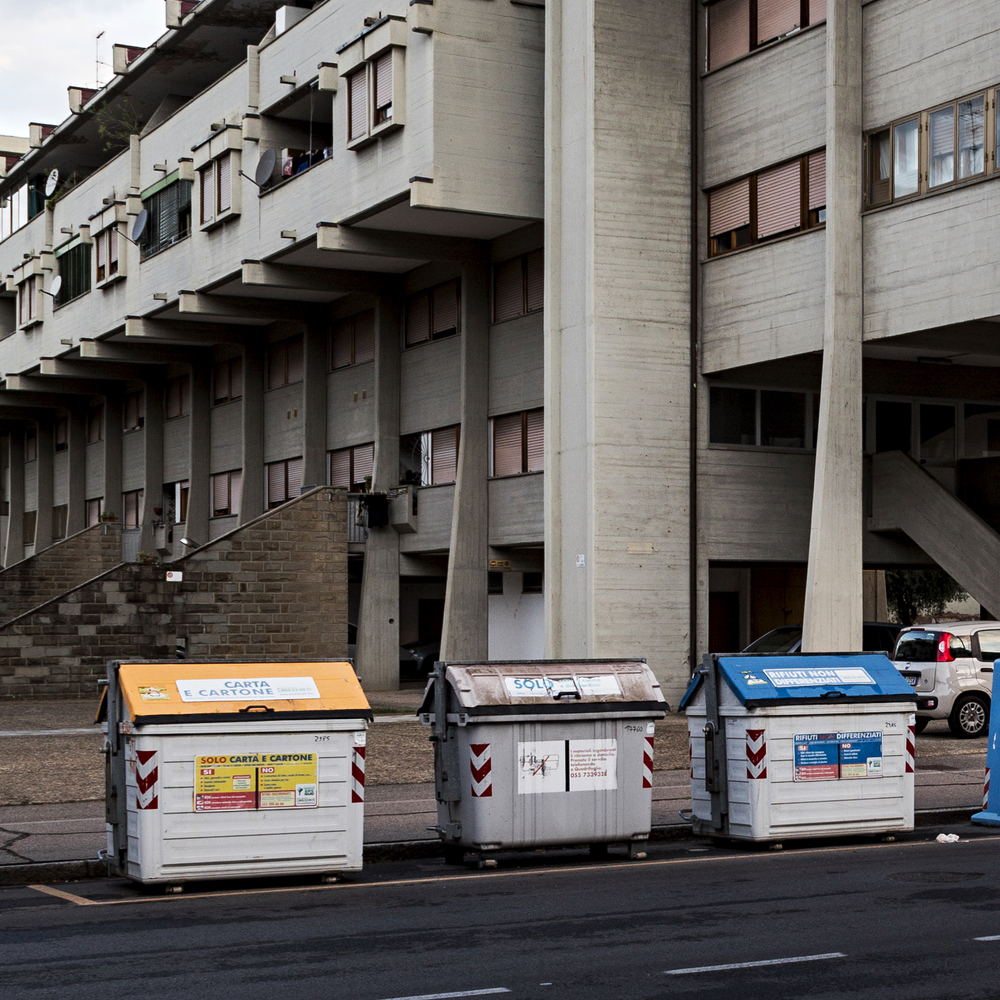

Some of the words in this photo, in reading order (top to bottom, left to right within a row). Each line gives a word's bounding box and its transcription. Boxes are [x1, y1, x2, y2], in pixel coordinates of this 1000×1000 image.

[224, 680, 271, 688] CARTA
[514, 679, 554, 689] SOLO
[774, 677, 842, 685] DIFFERENZIATI
[198, 688, 275, 697] CARTONE
[836, 731, 882, 740] DIFFERENZIATI
[200, 756, 227, 764] SOLO
[229, 755, 260, 763] CARTA
[269, 754, 313, 762] CARTONE
